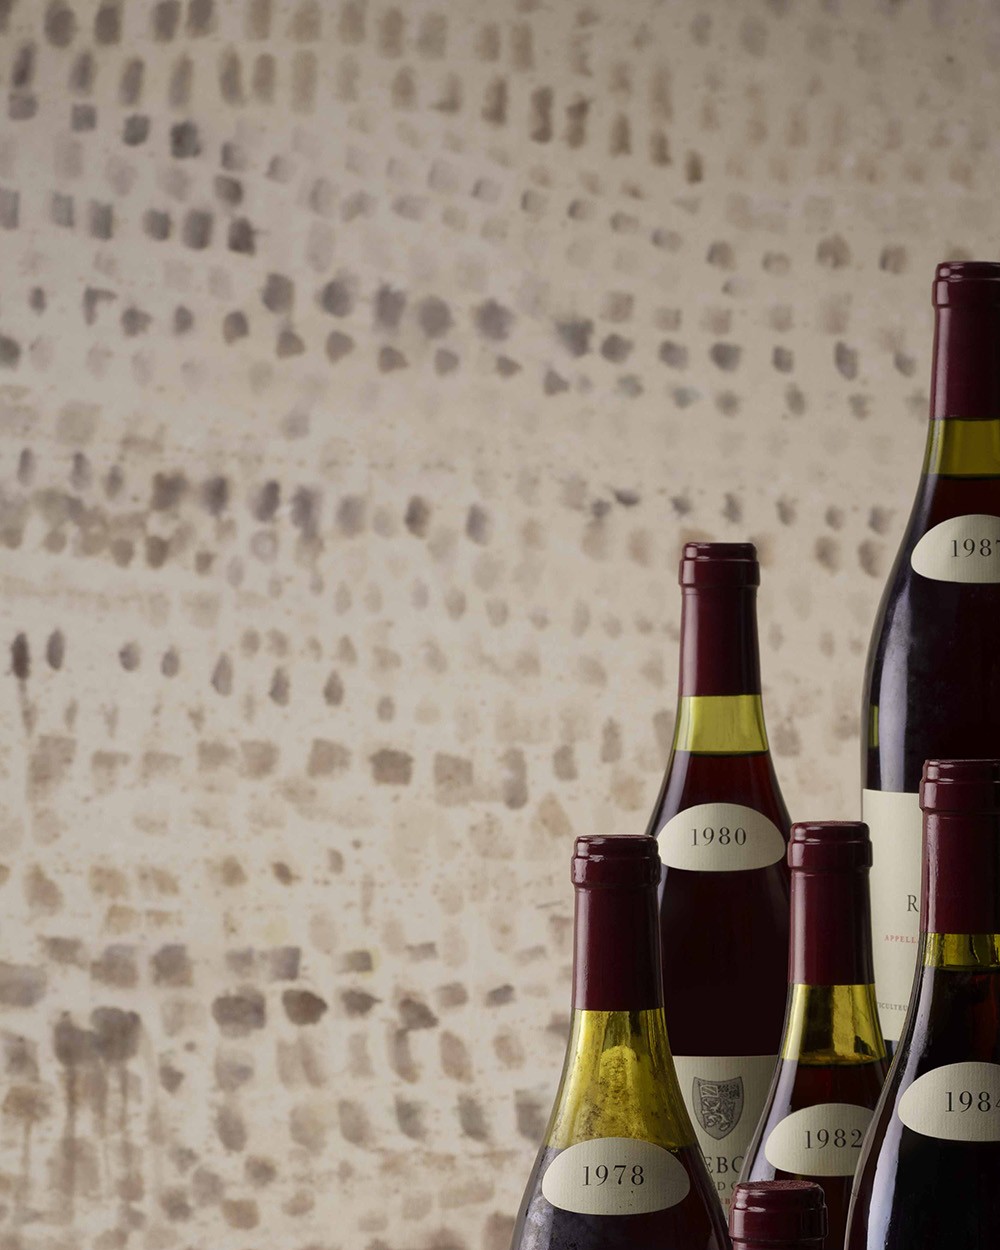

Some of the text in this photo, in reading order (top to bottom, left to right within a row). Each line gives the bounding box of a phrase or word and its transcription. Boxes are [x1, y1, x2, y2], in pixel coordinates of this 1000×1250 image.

[691, 826, 747, 847] 1980
[884, 934, 916, 945] APPELL
[805, 1128, 863, 1150] 1982
[582, 1164, 644, 1187] 1978
